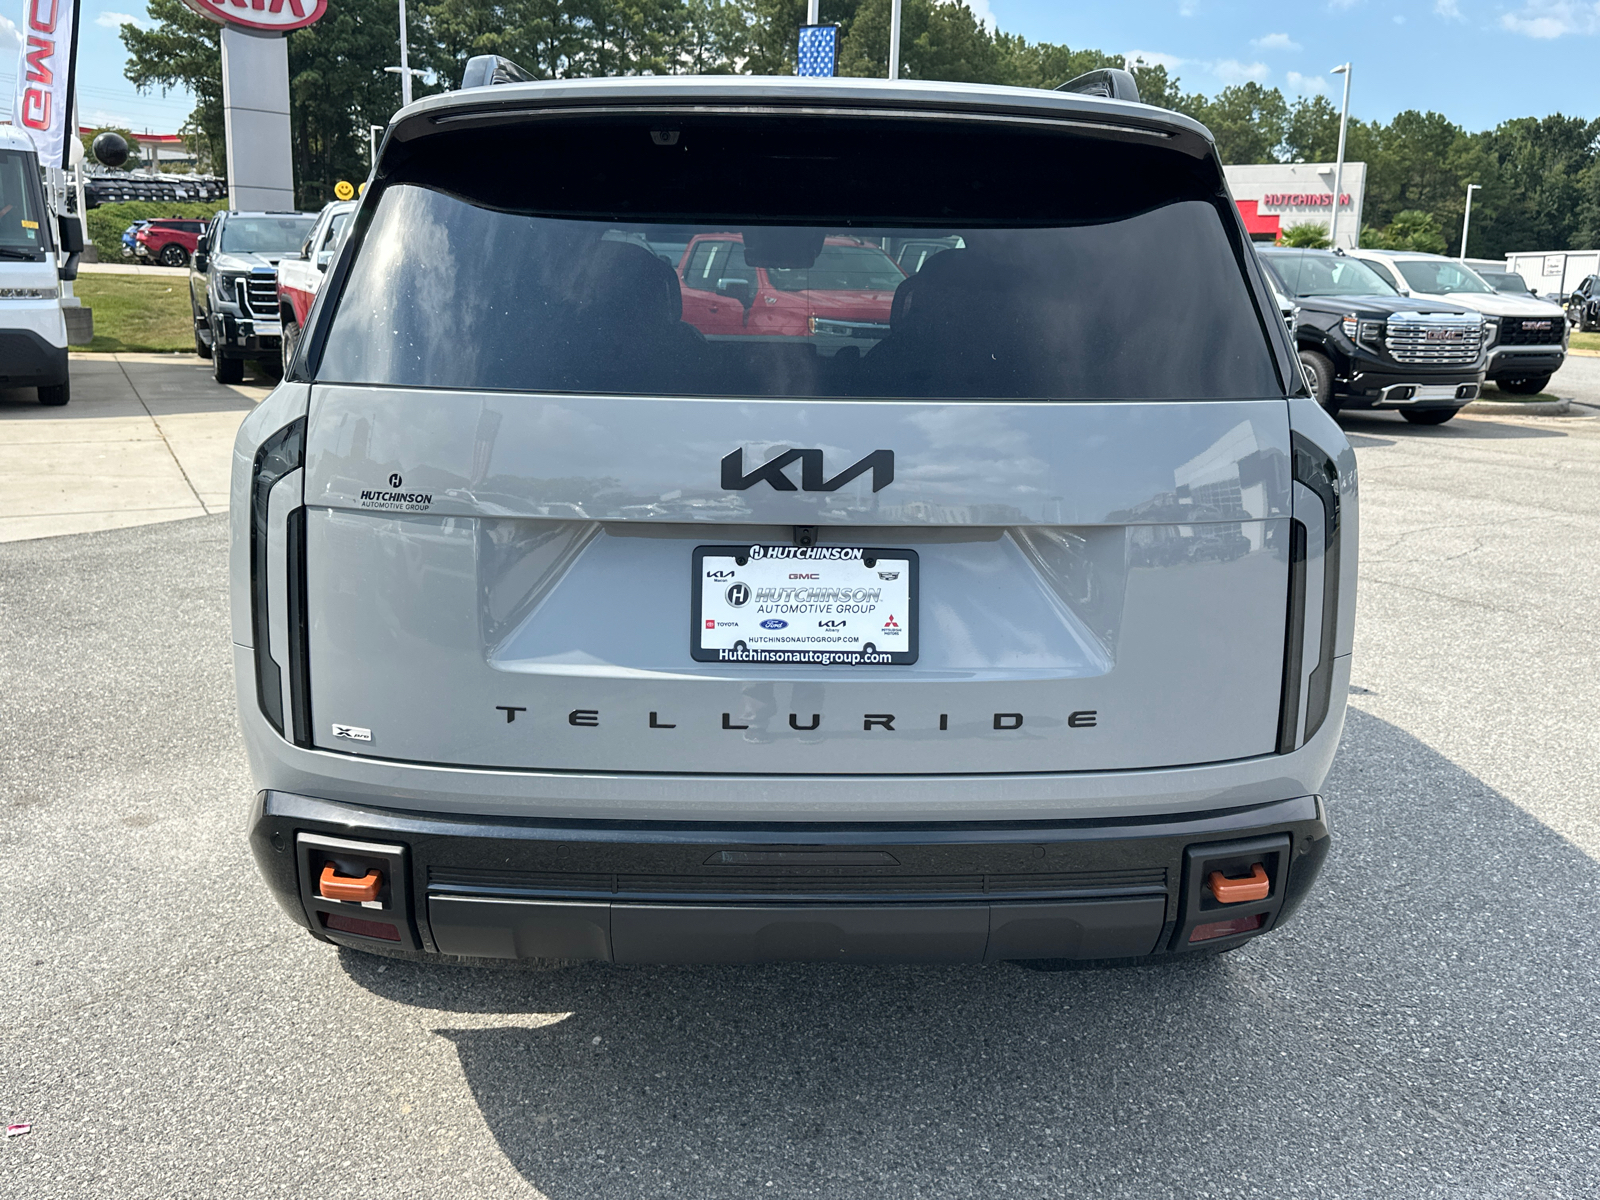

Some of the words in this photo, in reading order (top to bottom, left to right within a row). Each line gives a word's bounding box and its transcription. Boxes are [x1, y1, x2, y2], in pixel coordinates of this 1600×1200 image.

[360, 490, 433, 504] HUTCHINSON
[361, 501, 404, 510] AUTOMOTIVE
[405, 503, 430, 511] GROUP
[766, 547, 864, 560] HUTCHINSON
[754, 587, 882, 603] HUTCHINSON
[756, 604, 833, 614] AUTOMOTIVE
[835, 604, 876, 614] GROUP
[719, 649, 892, 665] Hutchinsonautogroup.com
[495, 705, 1098, 731] TELLURIDE
